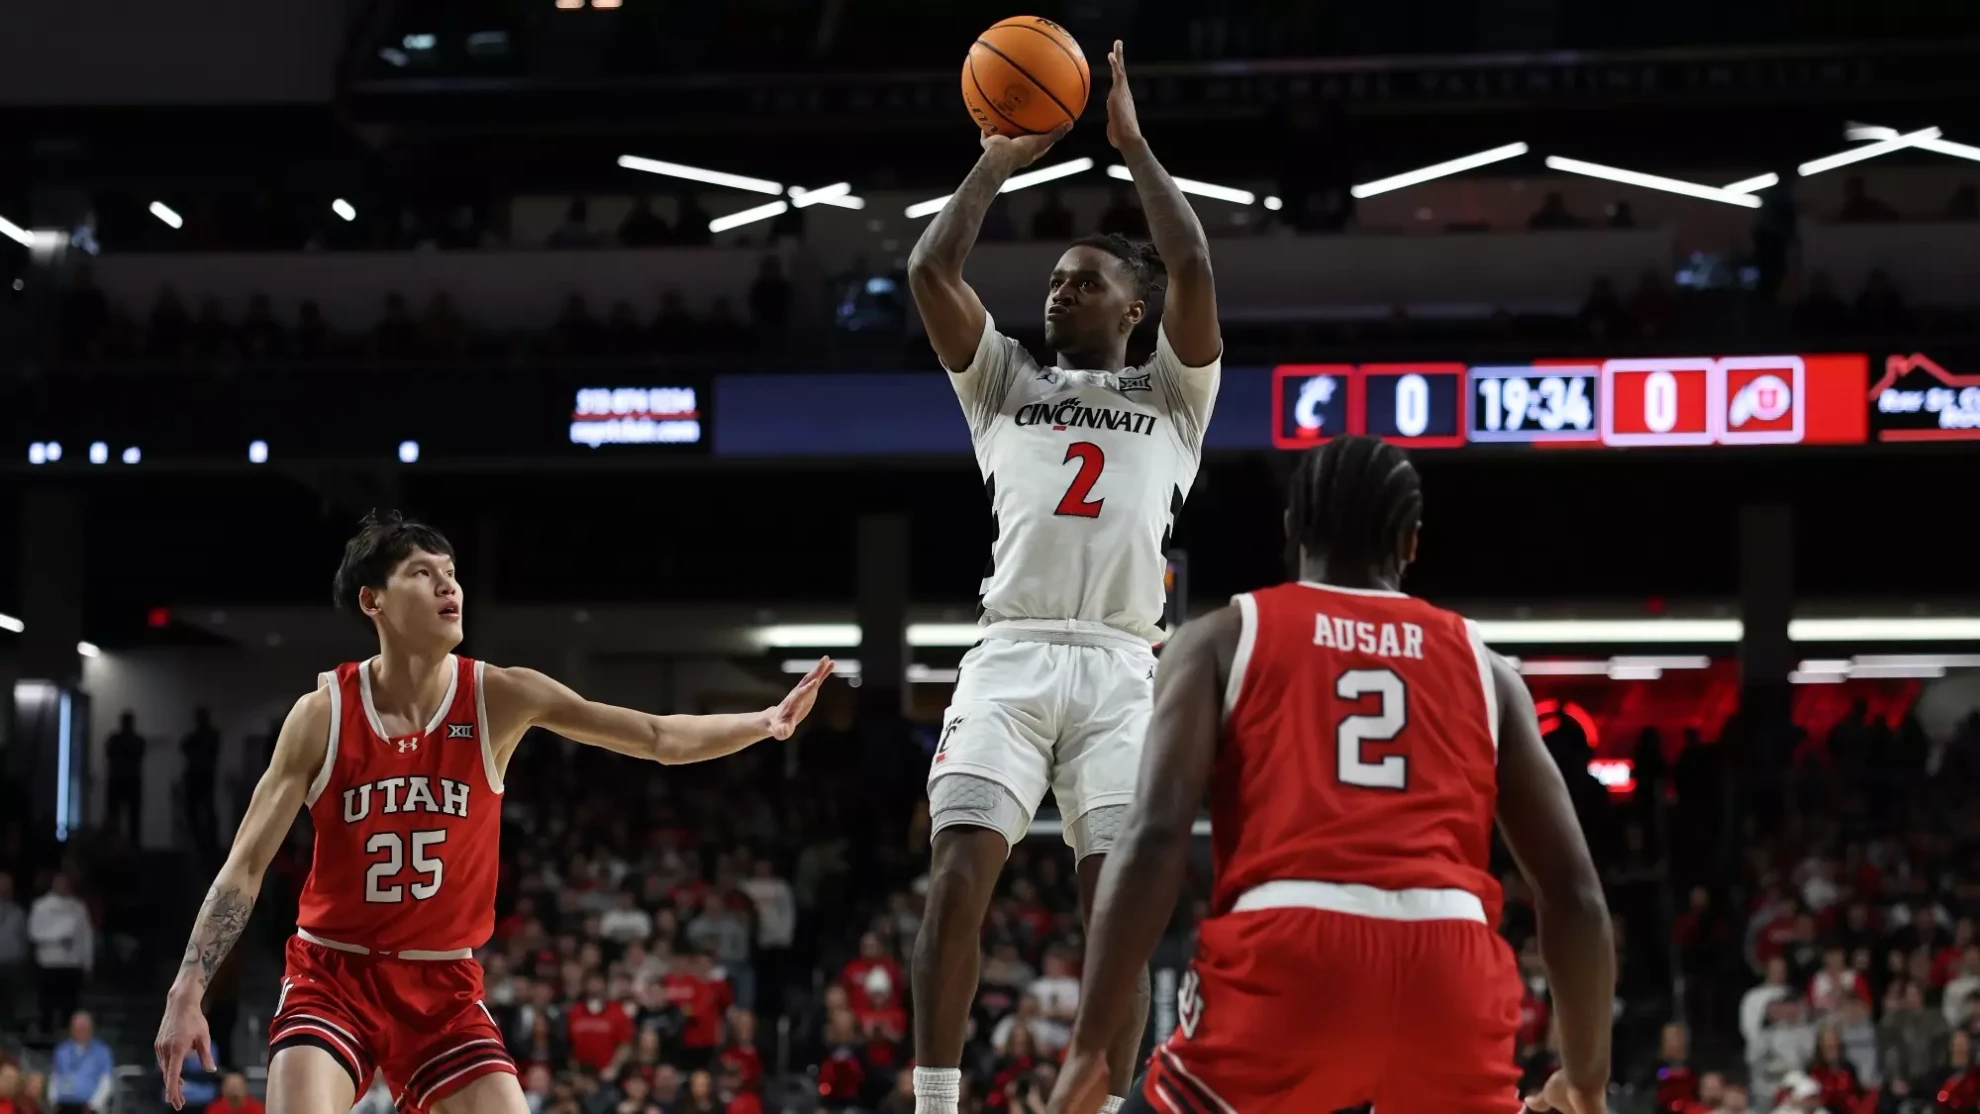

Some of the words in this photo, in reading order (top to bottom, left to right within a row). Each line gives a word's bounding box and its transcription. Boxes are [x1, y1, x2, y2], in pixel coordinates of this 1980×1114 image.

[1014, 398, 1158, 436] CINCINNATI
[1396, 373, 1428, 436] 0
[1478, 376, 1592, 431] 19:34
[1644, 371, 1677, 433] 0
[1053, 441, 1106, 519] 2
[1313, 612, 1424, 660] AUSAR
[1335, 668, 1408, 791] 2
[343, 776, 470, 824] UTAH
[365, 828, 447, 903] 25
